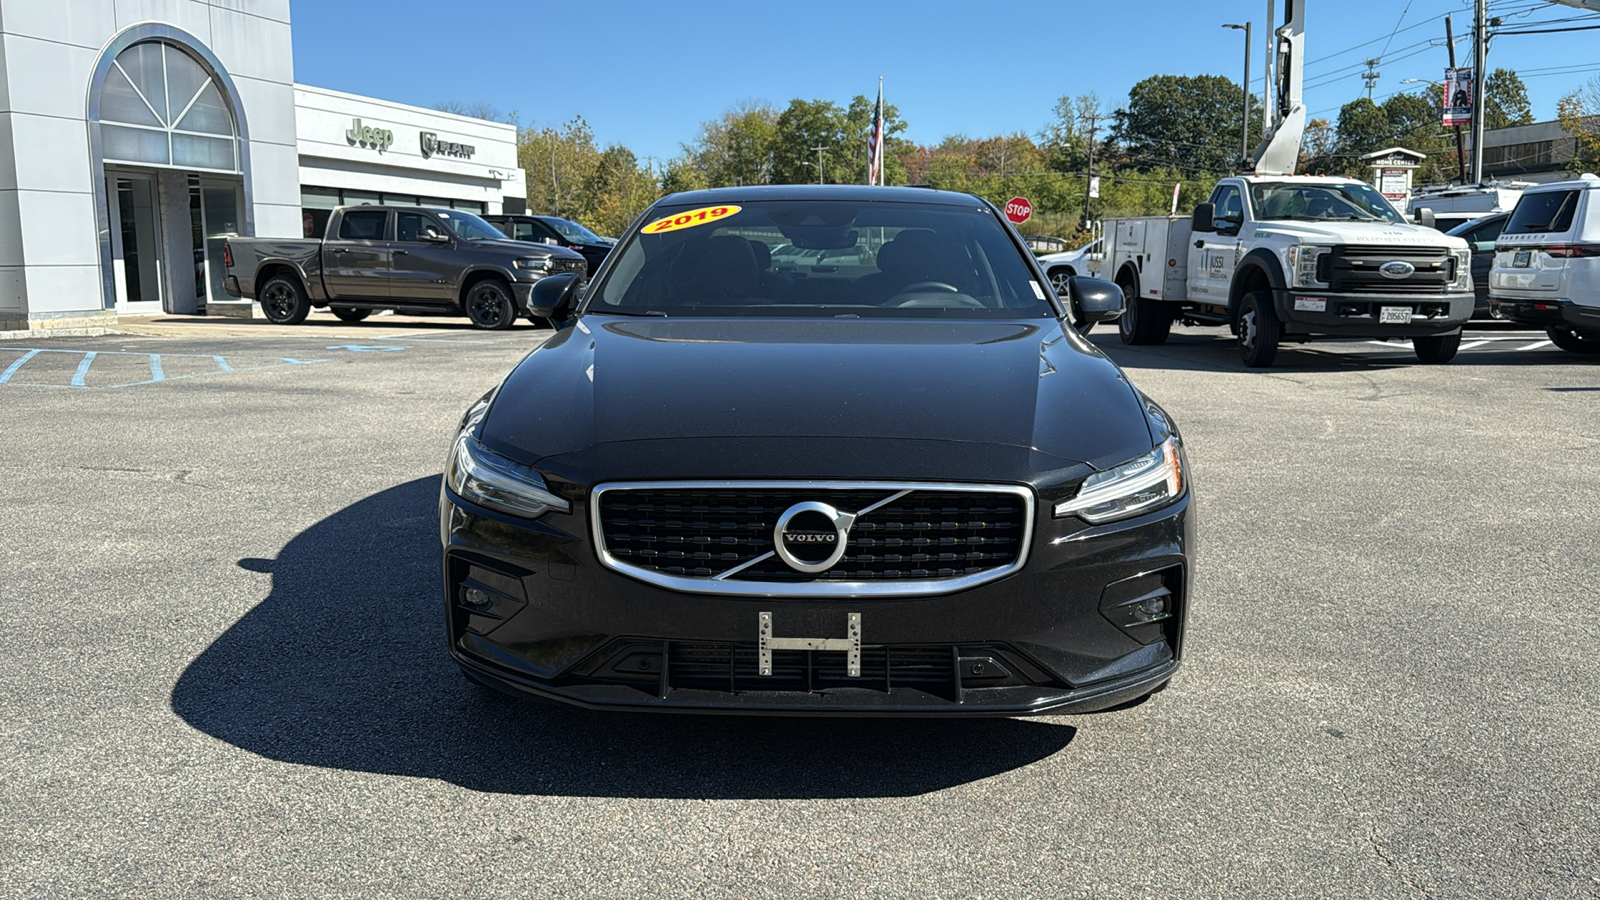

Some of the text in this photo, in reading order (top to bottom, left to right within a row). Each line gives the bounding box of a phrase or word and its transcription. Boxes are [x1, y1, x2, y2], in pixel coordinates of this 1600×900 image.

[346, 118, 394, 151] Jeep
[438, 140, 475, 156] RAM
[1007, 203, 1030, 216] STOP
[654, 207, 728, 231] 2019
[785, 534, 835, 542] VOLVO
